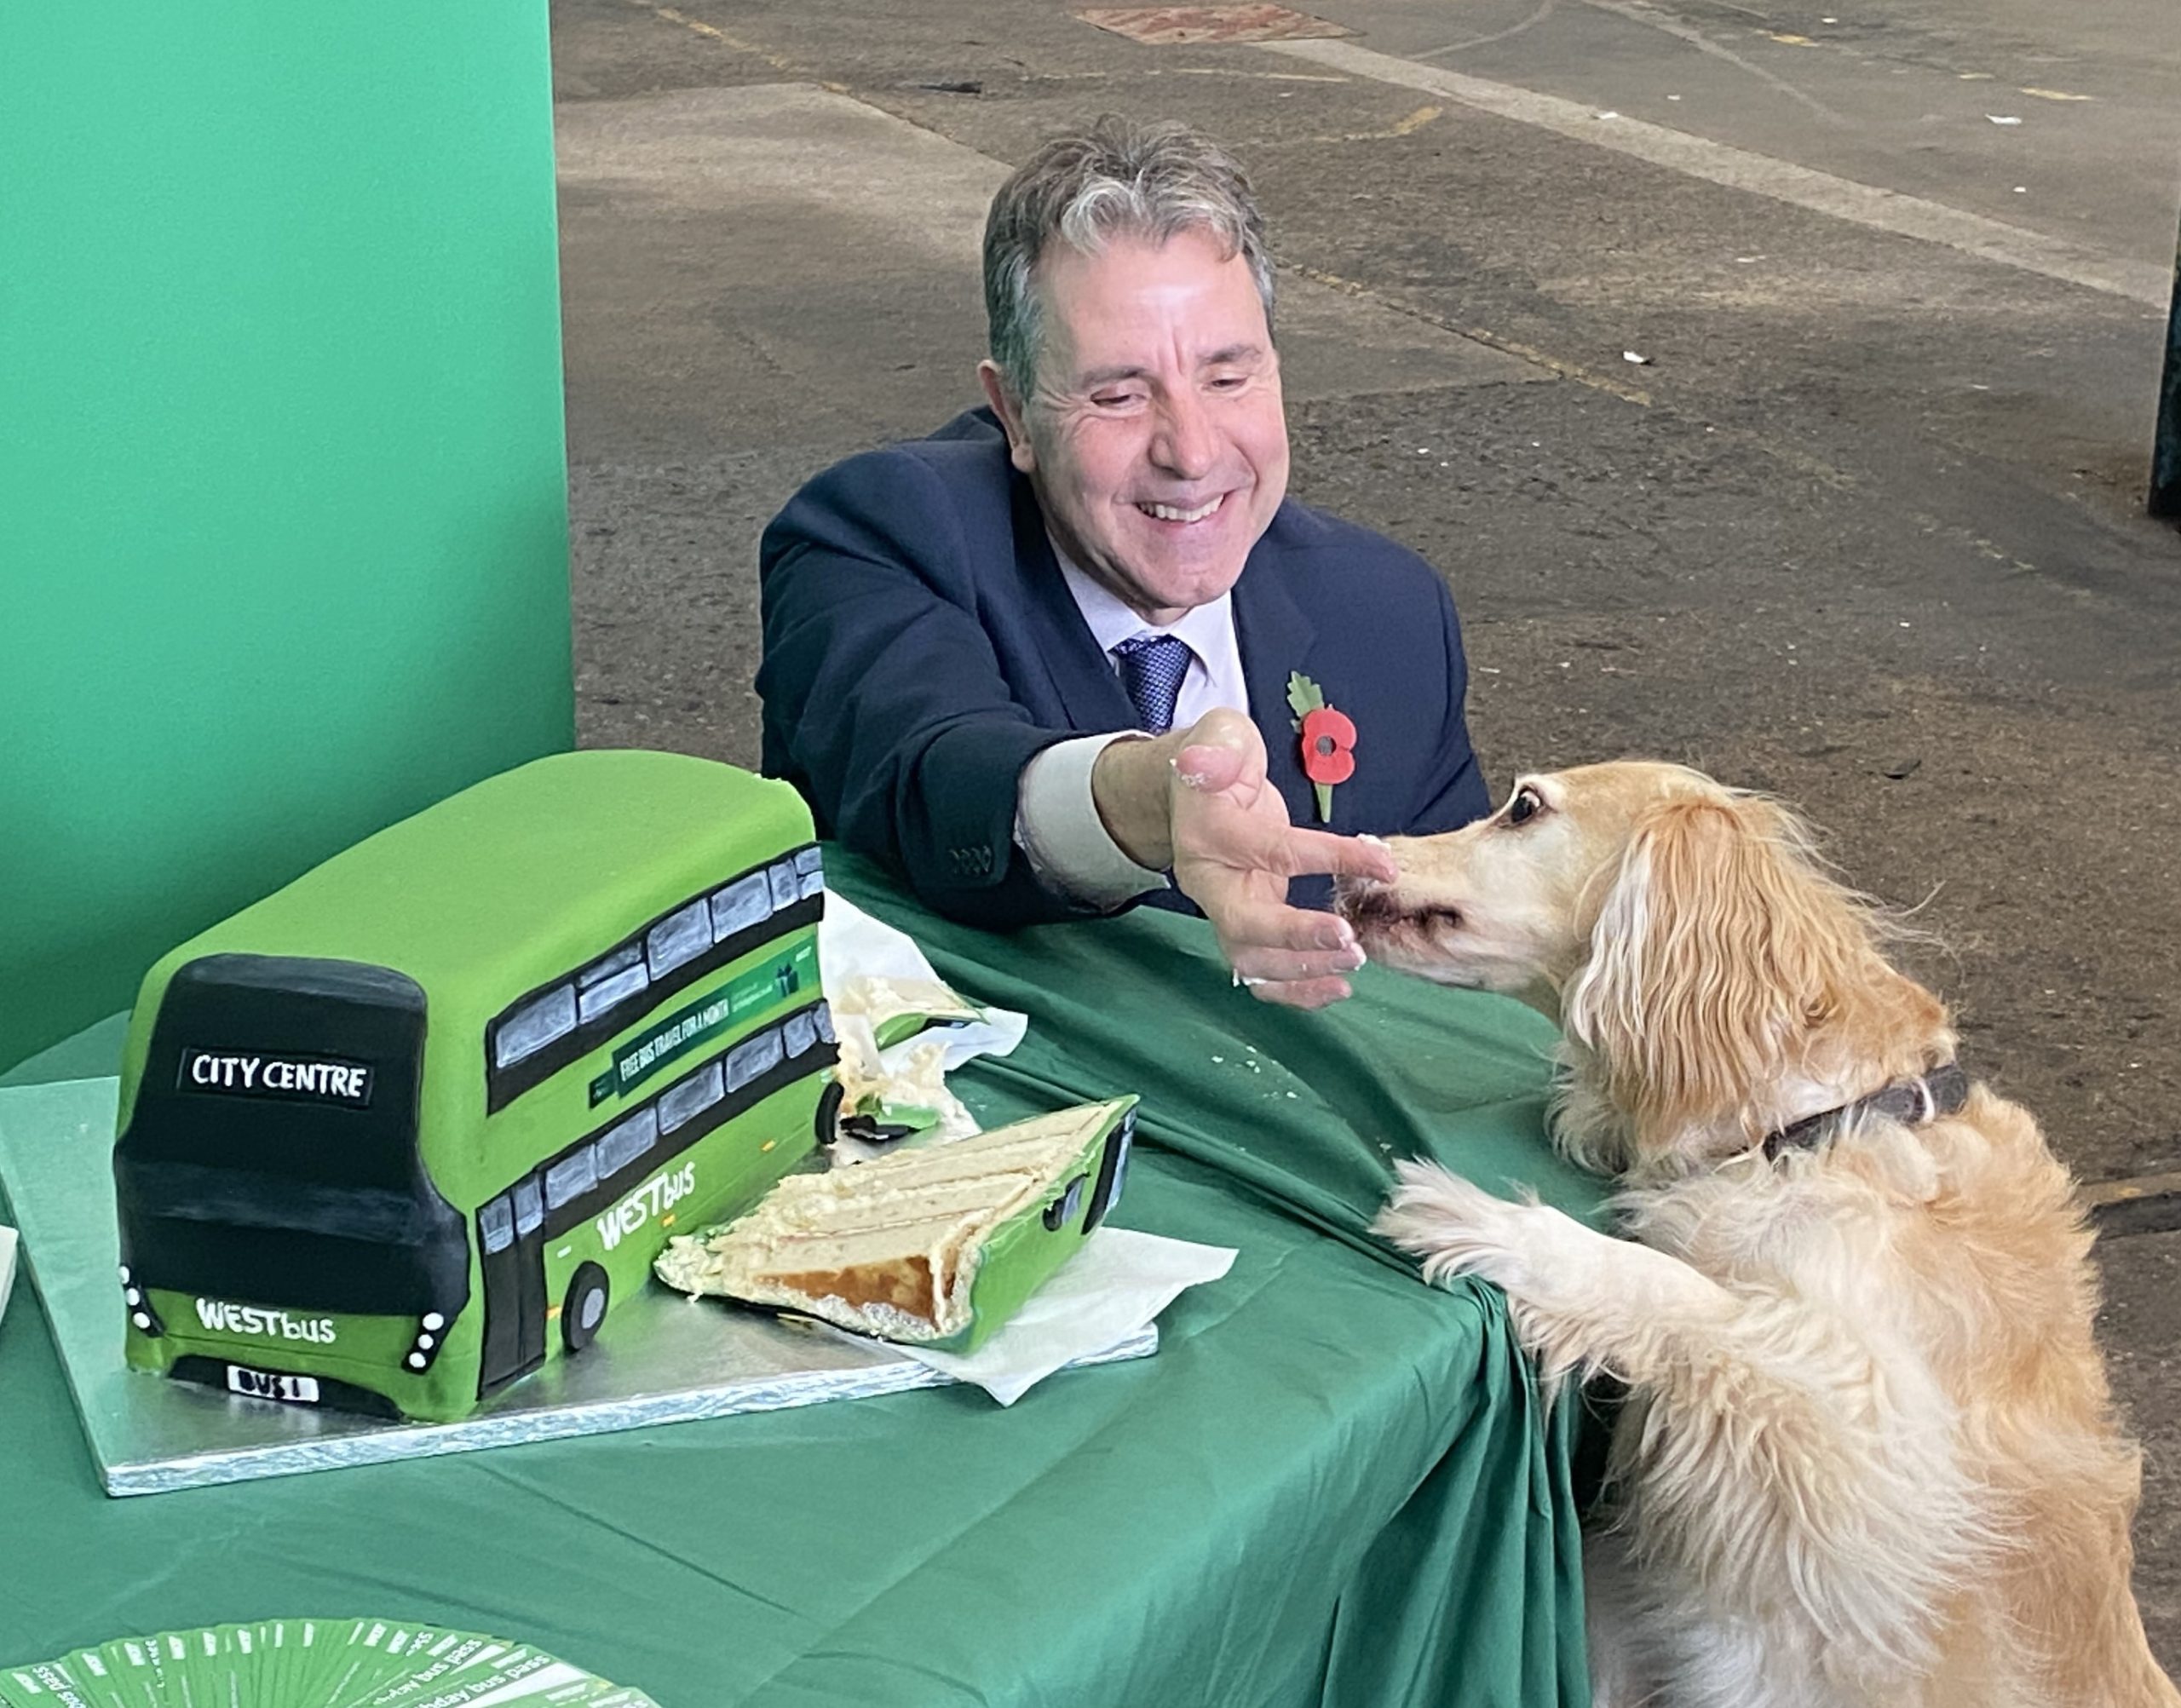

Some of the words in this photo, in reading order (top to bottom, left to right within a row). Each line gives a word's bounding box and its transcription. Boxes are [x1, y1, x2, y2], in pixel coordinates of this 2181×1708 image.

[193, 1055, 260, 1088] CITY
[262, 1061, 366, 1097] CENTRE
[32, 1665, 72, 1692] pass
[464, 1675, 507, 1694] bus
[504, 1655, 551, 1680] pass
